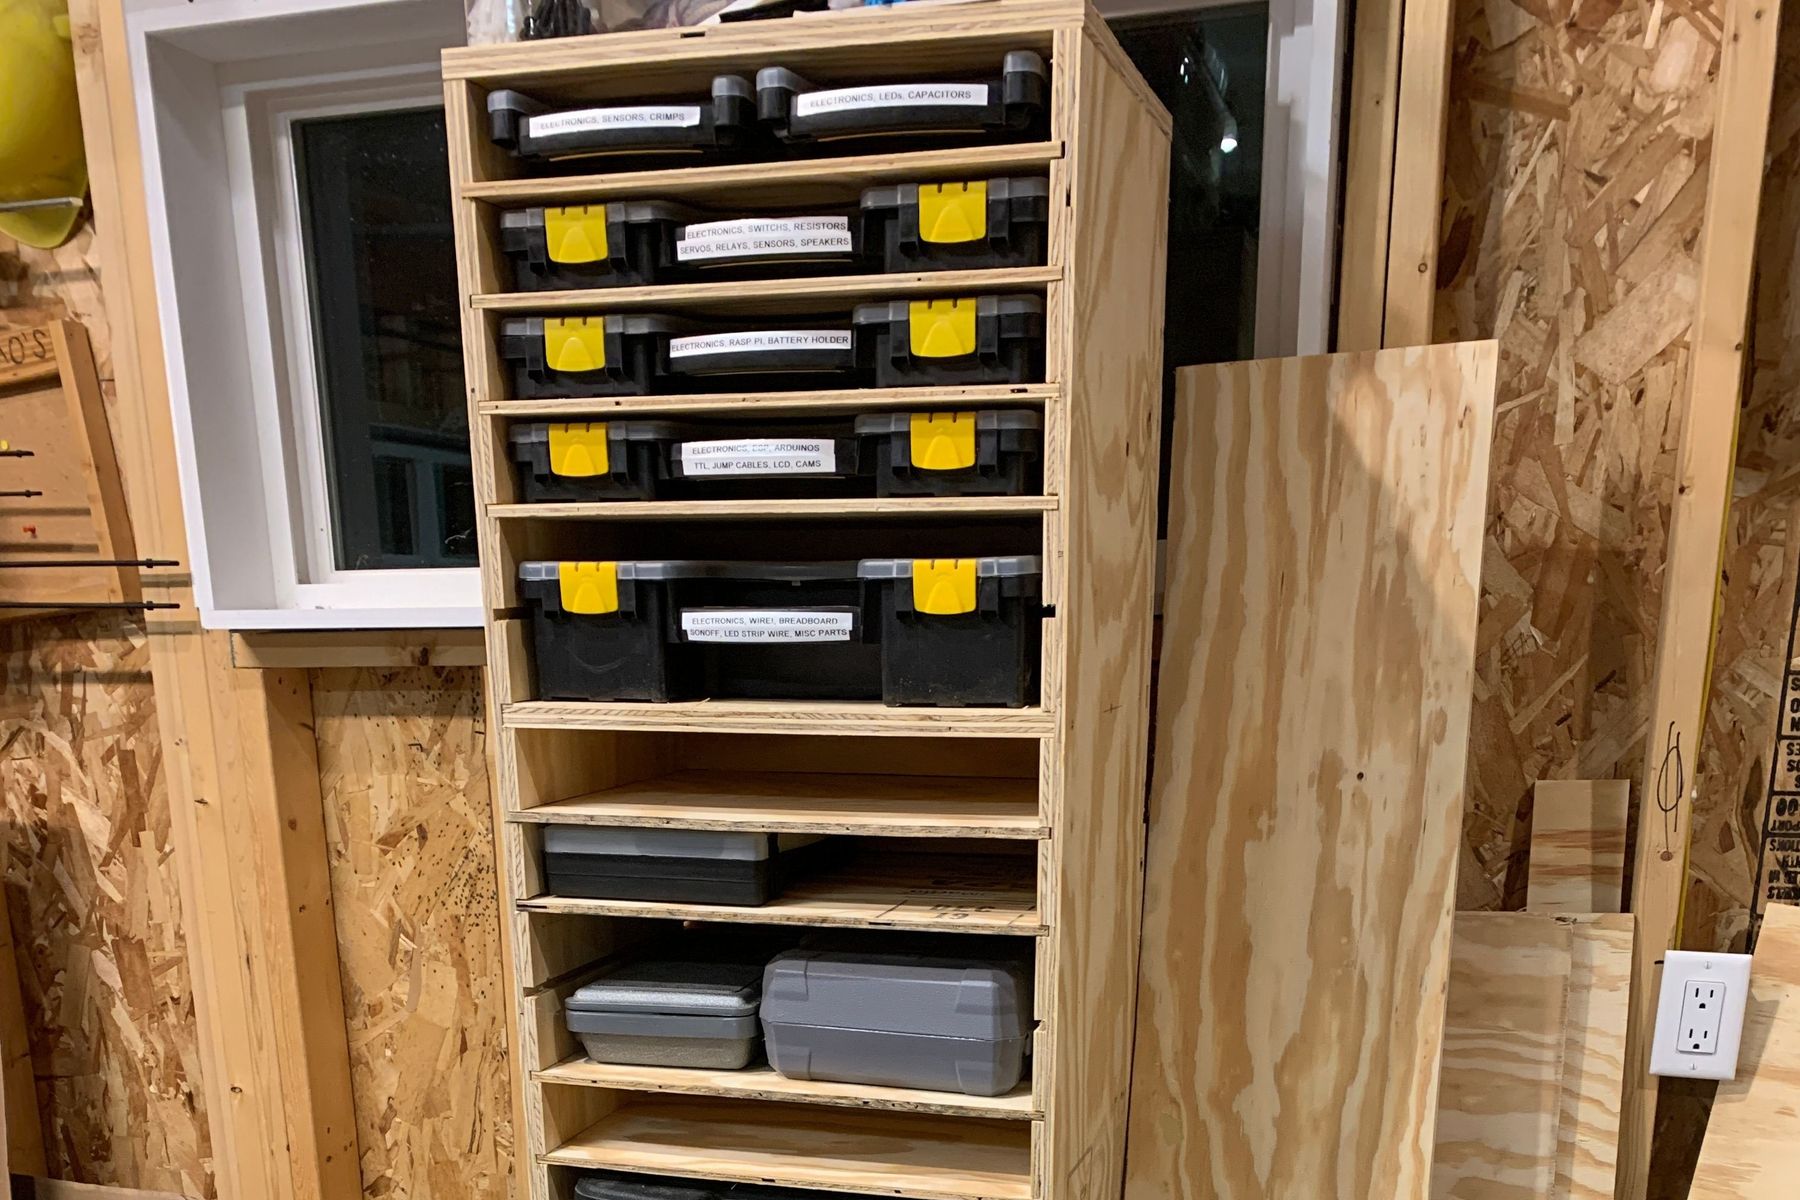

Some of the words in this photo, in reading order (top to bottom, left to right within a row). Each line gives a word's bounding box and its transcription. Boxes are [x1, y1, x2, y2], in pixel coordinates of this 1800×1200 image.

[908, 90, 972, 100] CAPACITORS
[602, 113, 647, 124] SENSORS,
[650, 112, 685, 122] CRIMPS
[687, 226, 744, 240] ELECTRONICS,
[747, 223, 791, 233] SWITCHS,
[793, 222, 847, 231] RESISTORS
[680, 245, 713, 255] SERVOS,
[716, 241, 751, 251] RELAYS,
[753, 239, 798, 249] SENSORS,
[800, 237, 849, 247] SPEAKERS
[0, 329, 47, 364] O'S
[671, 340, 727, 352] ELECTRONICS,
[729, 338, 752, 347] RASP
[768, 336, 809, 345] BATTERY
[812, 335, 849, 345] HOLDER
[774, 444, 820, 452] ARDUINOS
[712, 461, 733, 470] JUMP
[795, 459, 822, 468] CAMS
[724, 629, 740, 638] LED
[741, 630, 766, 638] STRIP
[794, 629, 816, 638] MISC
[818, 628, 847, 637] PARTS
